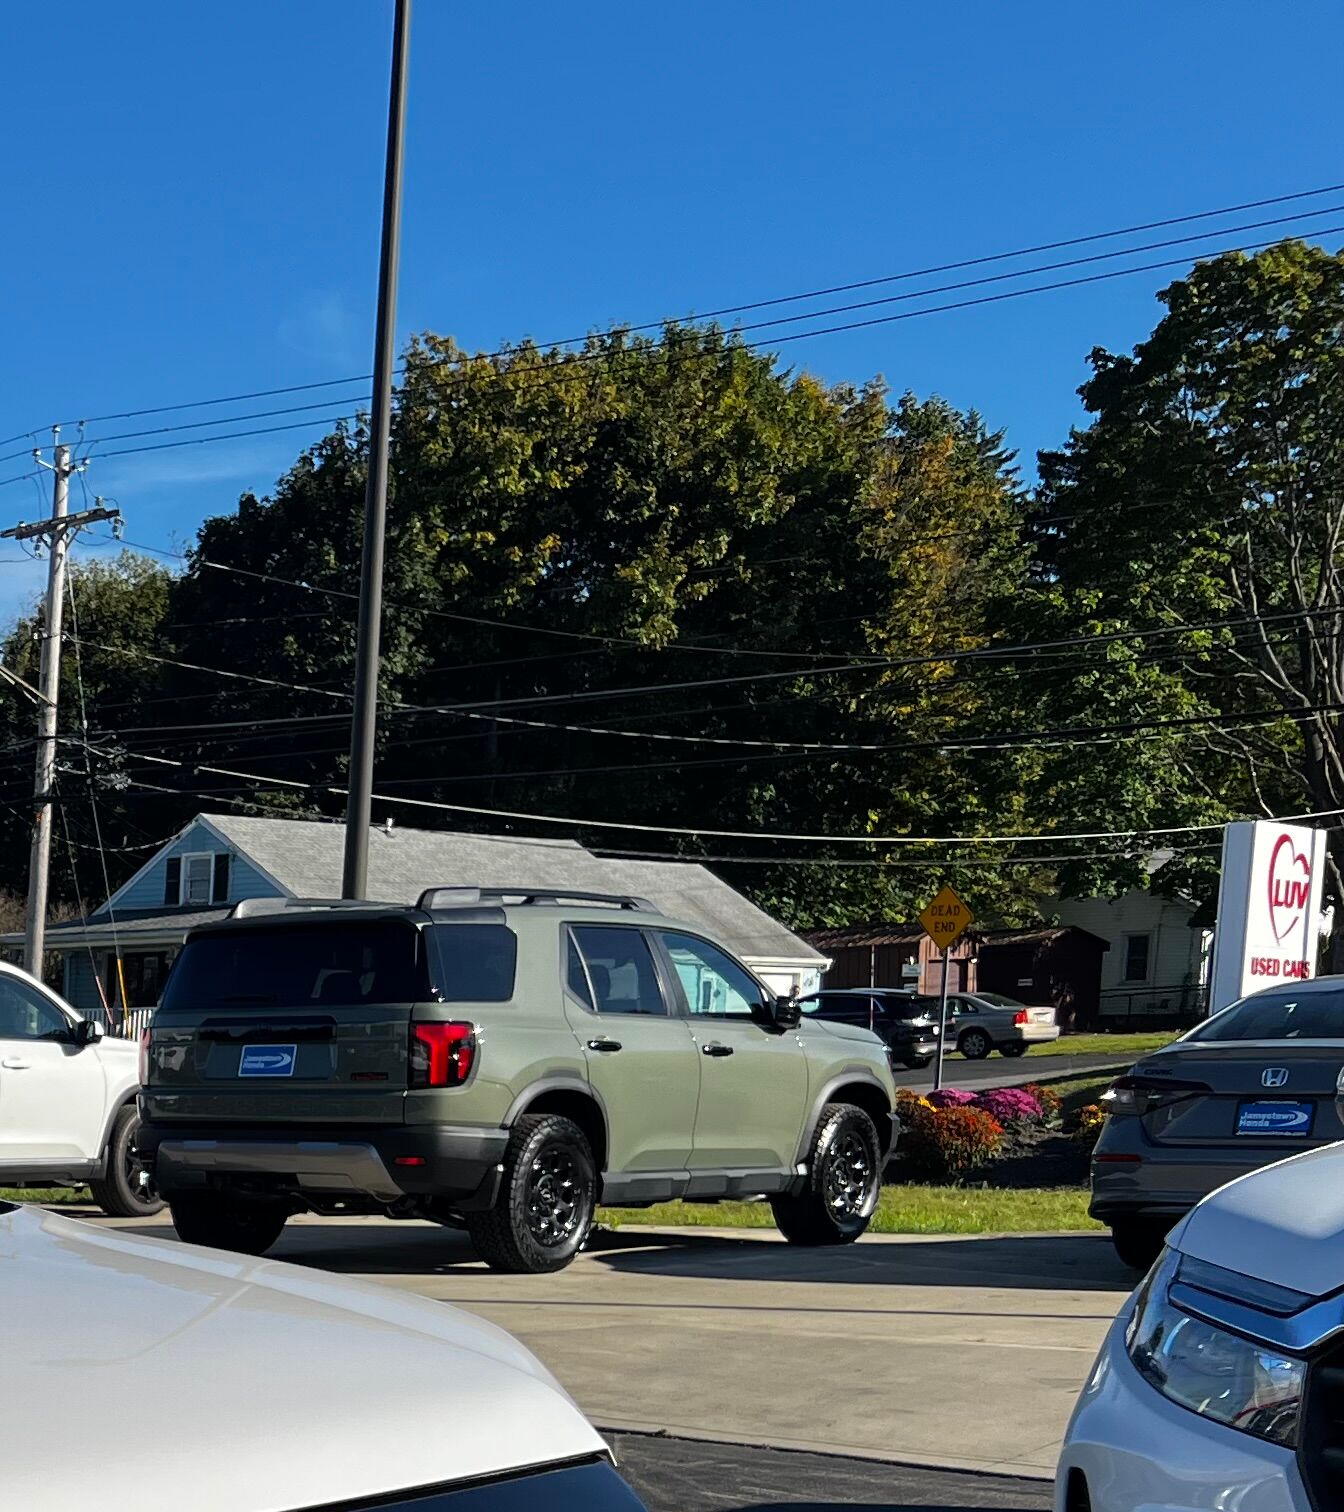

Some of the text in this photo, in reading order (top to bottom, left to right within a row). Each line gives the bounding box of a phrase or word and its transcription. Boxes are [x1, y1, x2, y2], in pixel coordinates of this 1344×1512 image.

[1273, 879, 1310, 909] LUV
[930, 905, 961, 917] DEAD
[934, 921, 956, 933] END
[1250, 956, 1310, 980] USED CARS
[1240, 1111, 1296, 1120] Jamestown
[1239, 1119, 1270, 1127] Honda
